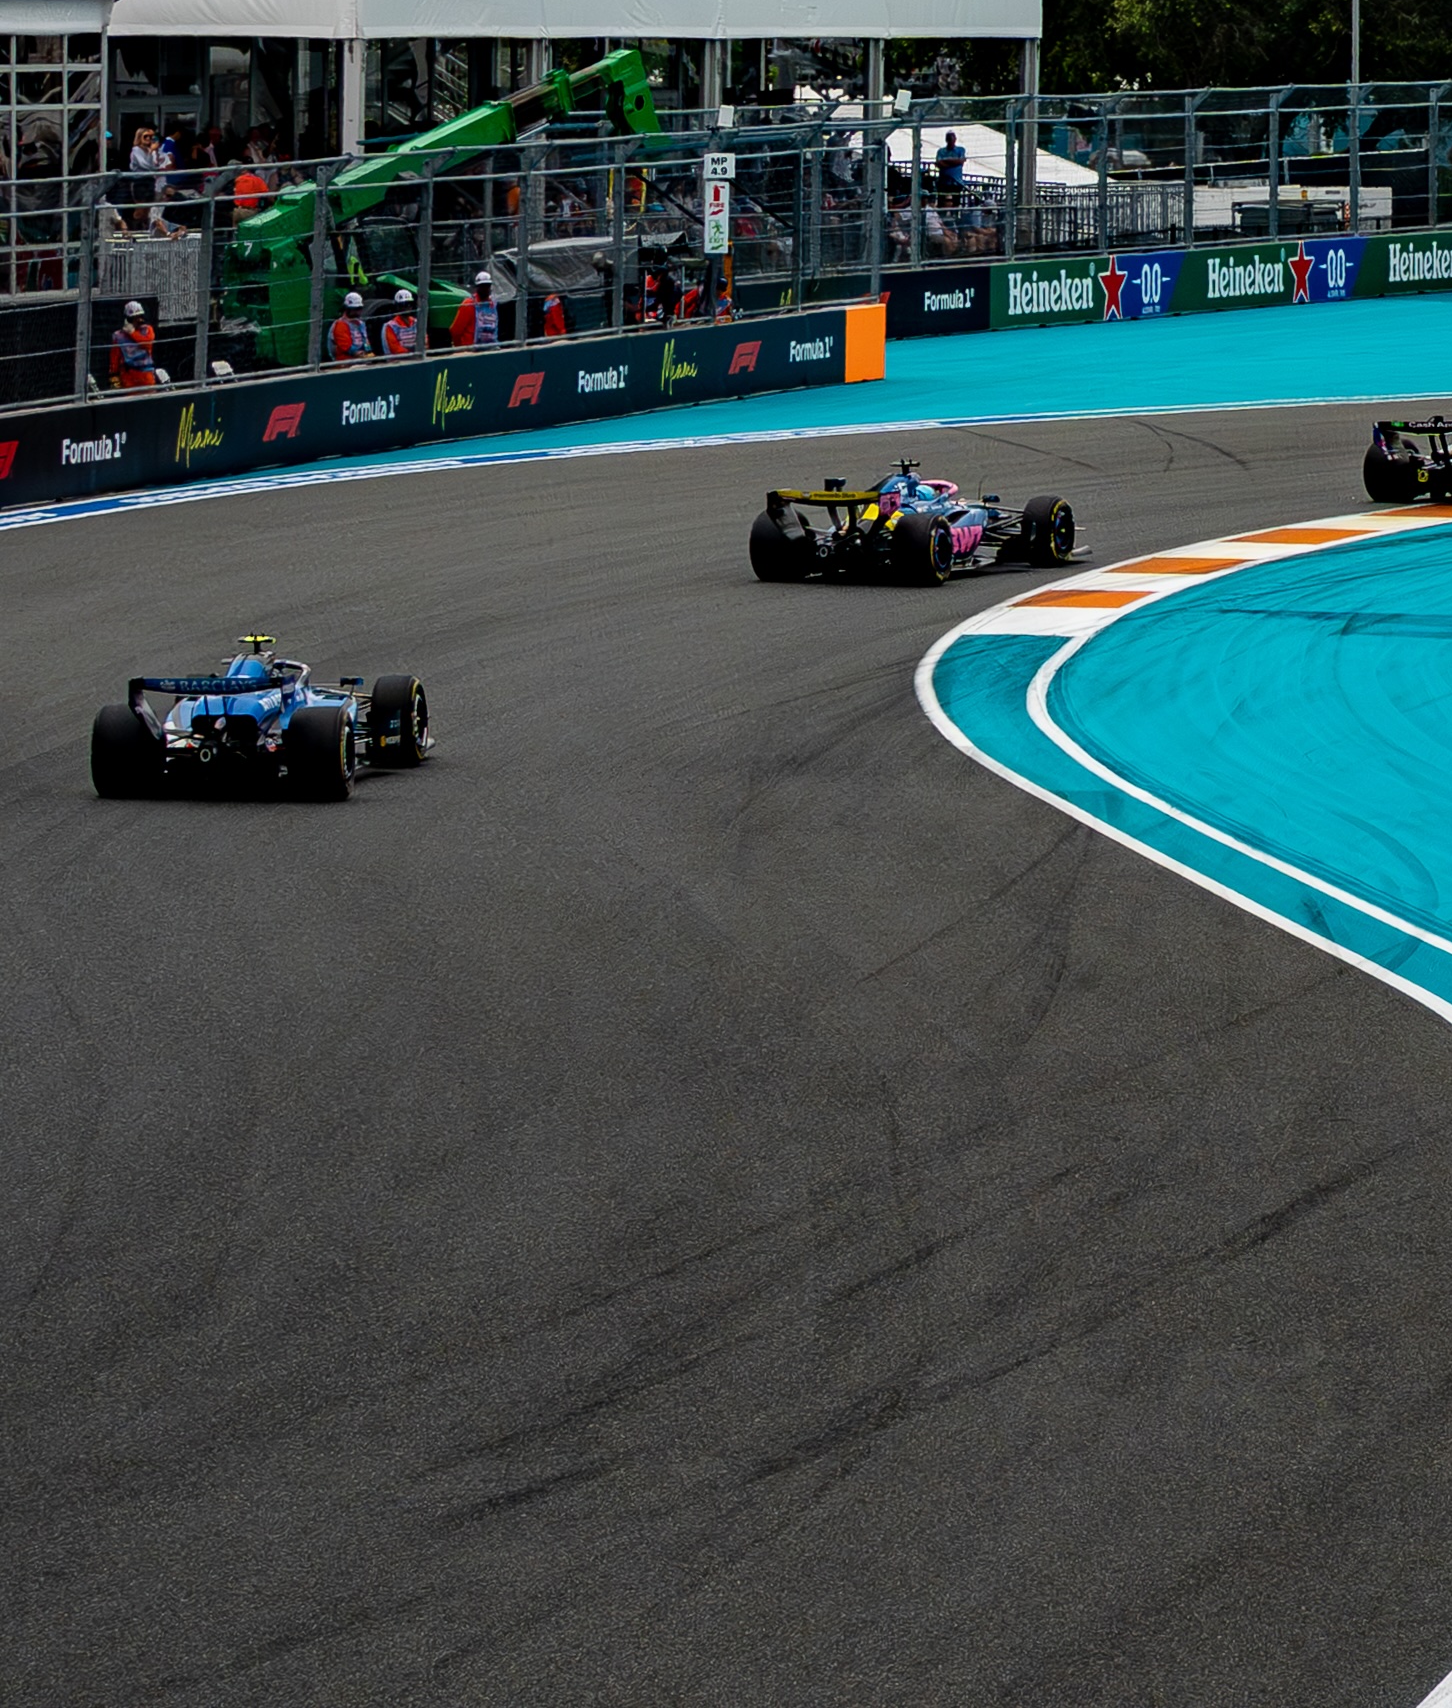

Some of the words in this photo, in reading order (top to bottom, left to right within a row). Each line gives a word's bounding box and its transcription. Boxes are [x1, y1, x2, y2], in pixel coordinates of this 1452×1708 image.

[710, 156, 728, 166] MP
[710, 166, 728, 176] 4.9
[1142, 263, 1161, 304] 0.0
[1327, 249, 1346, 288] 0.0
[924, 290, 964, 311] Formula
[789, 339, 825, 363] Formula
[578, 368, 618, 393] Formula
[660, 338, 698, 396] Miami
[342, 396, 386, 425] Formula
[432, 368, 476, 431] Miami
[62, 434, 112, 466] Formula
[175, 402, 224, 468] Miami
